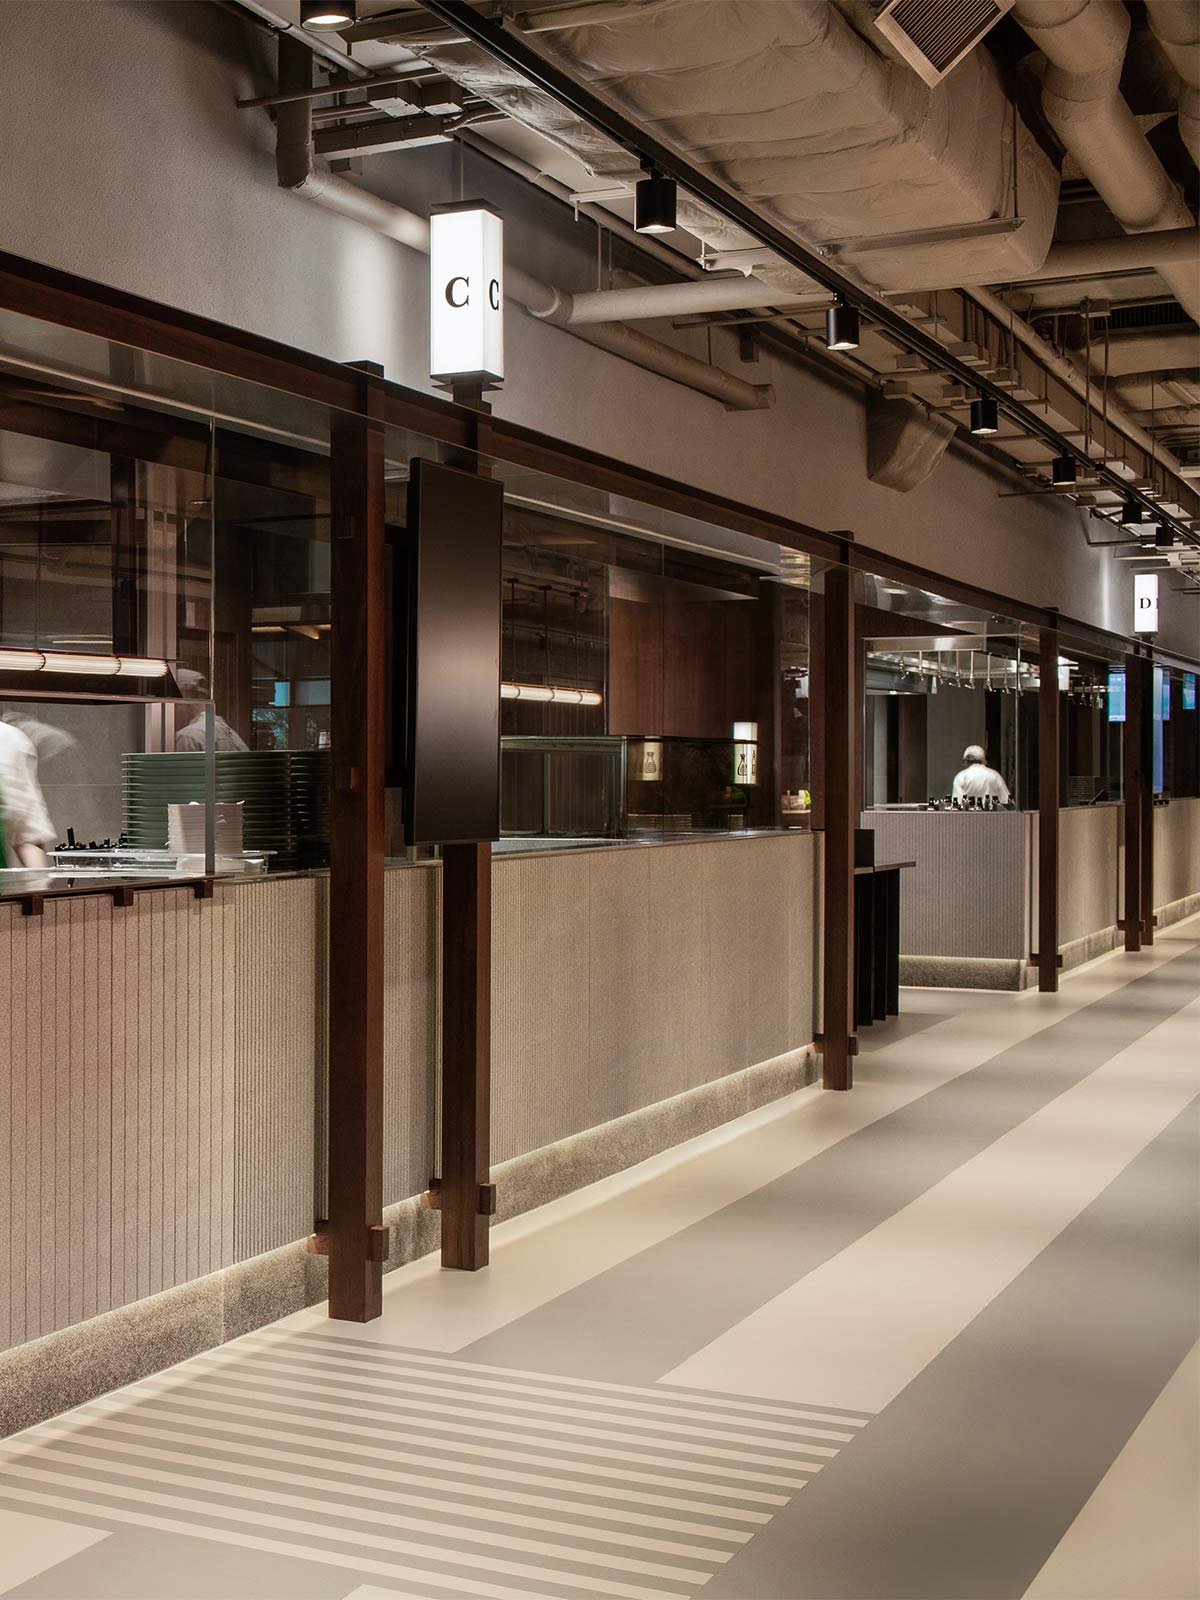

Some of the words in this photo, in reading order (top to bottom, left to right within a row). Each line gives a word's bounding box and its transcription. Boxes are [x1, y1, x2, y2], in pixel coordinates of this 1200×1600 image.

[445, 276, 469, 308] C
[489, 279, 499, 311] C
[1140, 598, 1151, 609] D
